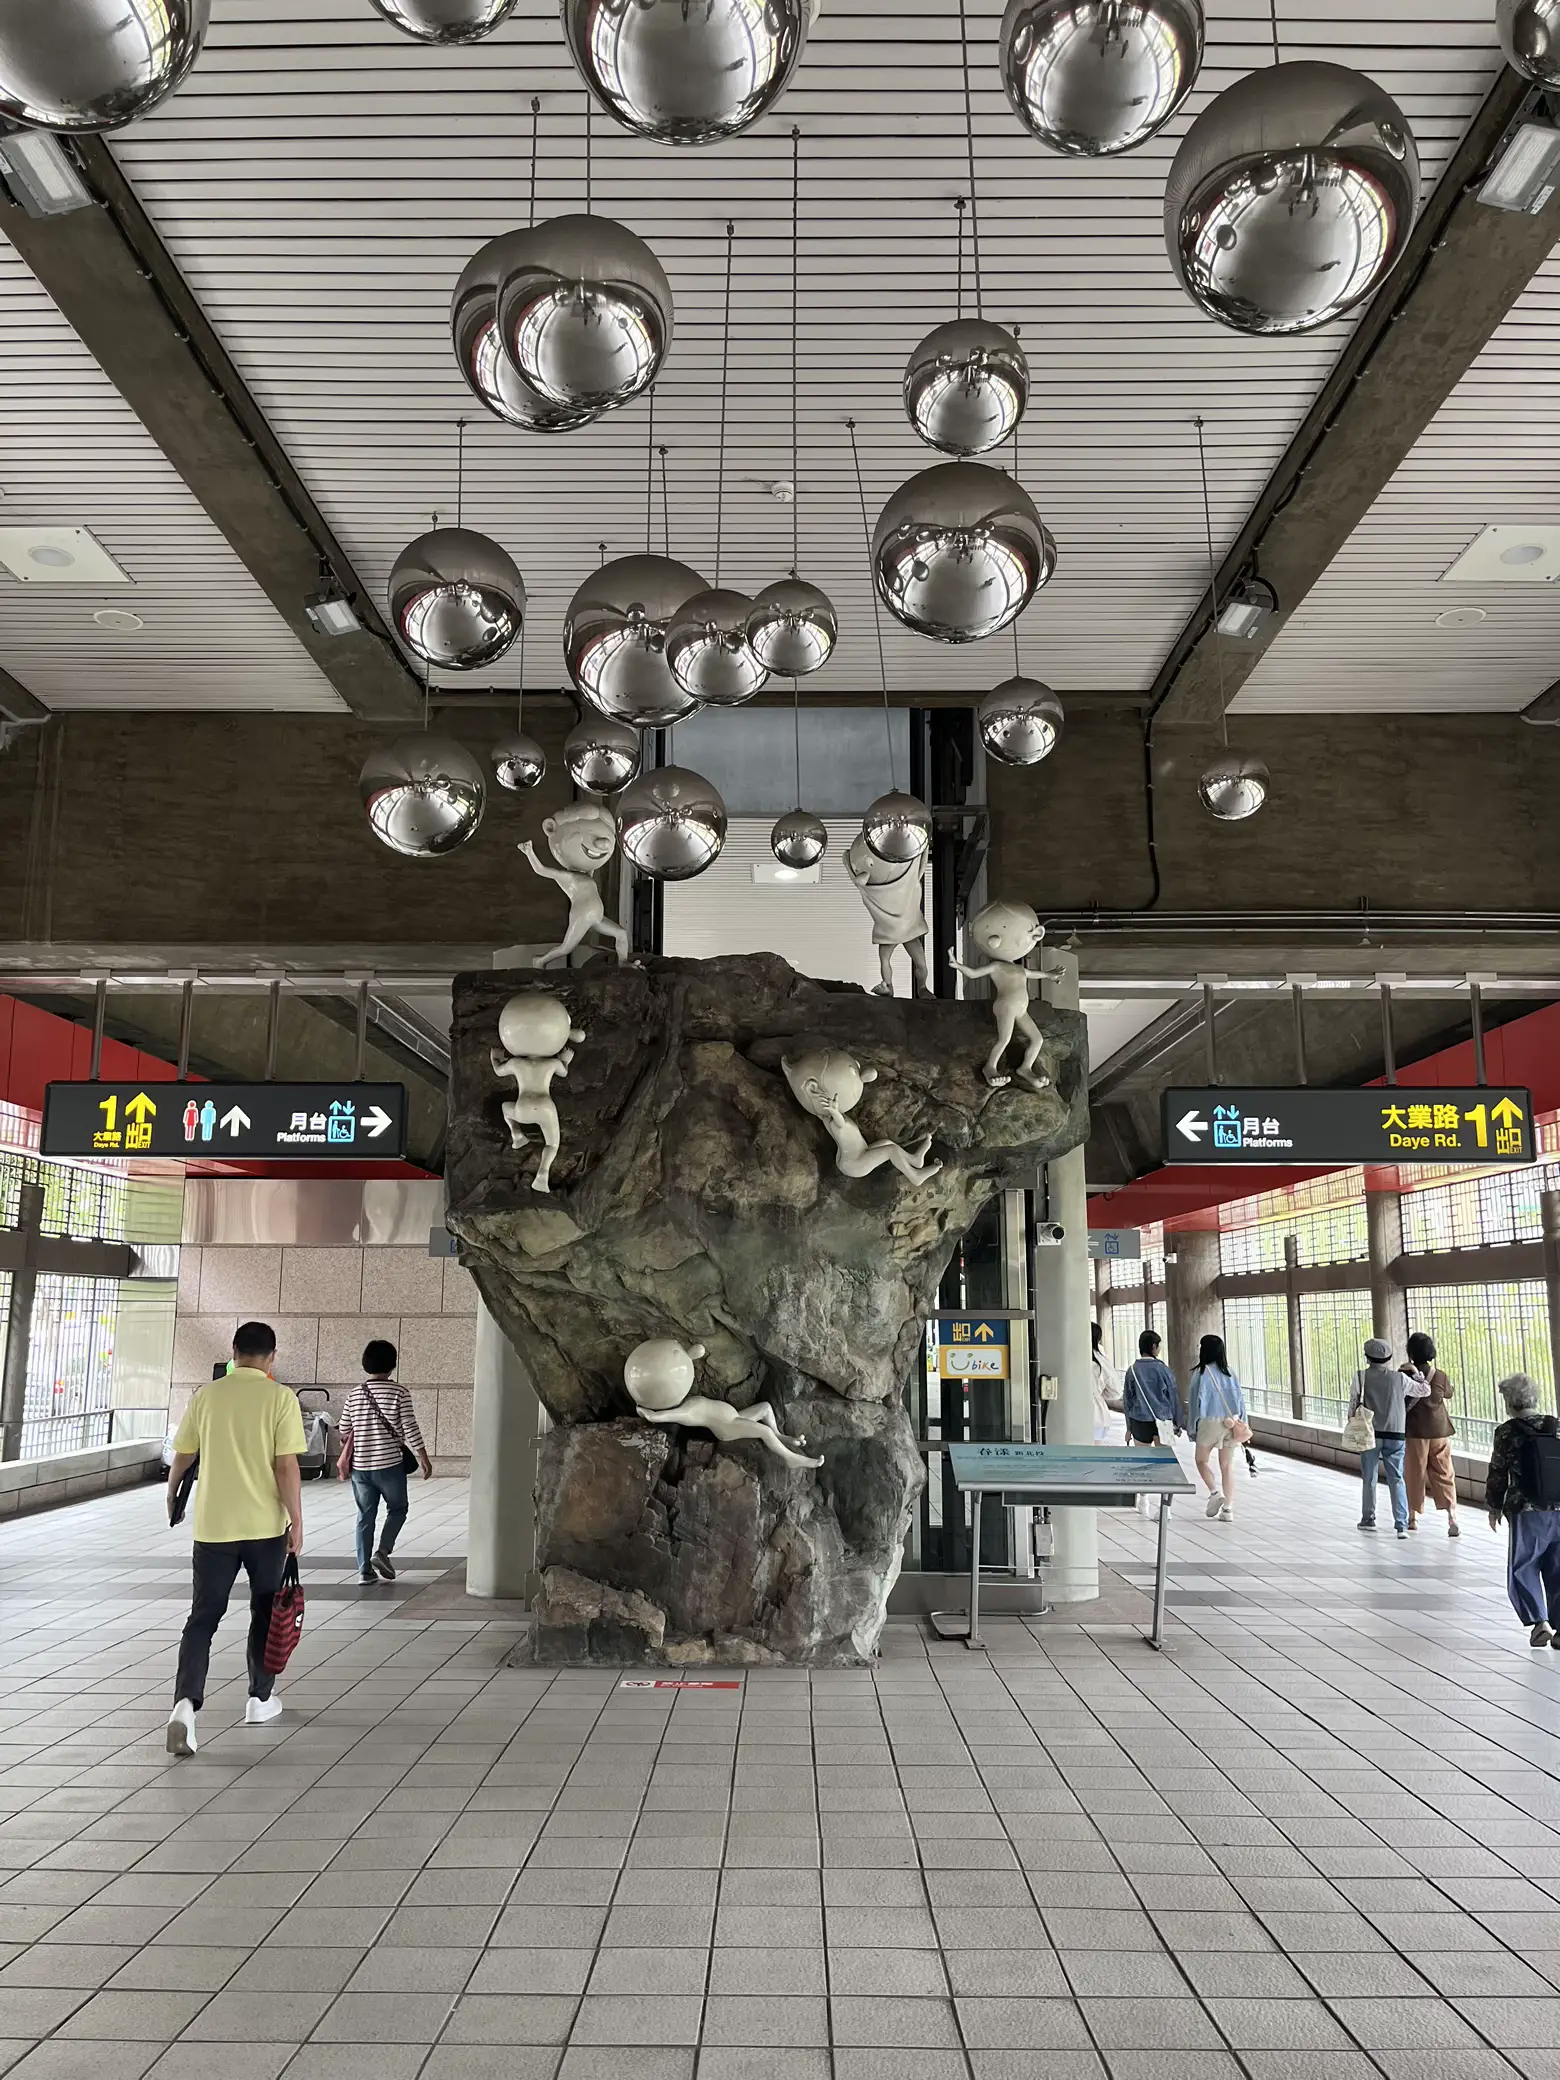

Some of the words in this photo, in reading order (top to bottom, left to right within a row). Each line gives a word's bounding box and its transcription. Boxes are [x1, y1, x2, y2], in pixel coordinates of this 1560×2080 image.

[99, 1095, 117, 1130] 1
[289, 1112, 328, 1131] 月台
[1381, 1104, 1460, 1129] 大業路
[1242, 1117, 1280, 1135] 月台
[1464, 1104, 1488, 1147] 1
[125, 1122, 153, 1149] 出口
[138, 1141, 151, 1149] EXIT
[277, 1131, 327, 1142] Platforms
[1242, 1137, 1294, 1148] Platforms
[1390, 1133, 1430, 1149] Daye
[1434, 1133, 1462, 1147] Rd.
[1495, 1127, 1522, 1155] 出口
[1509, 1146, 1523, 1154] EXIT
[952, 1322, 971, 1342] 出口
